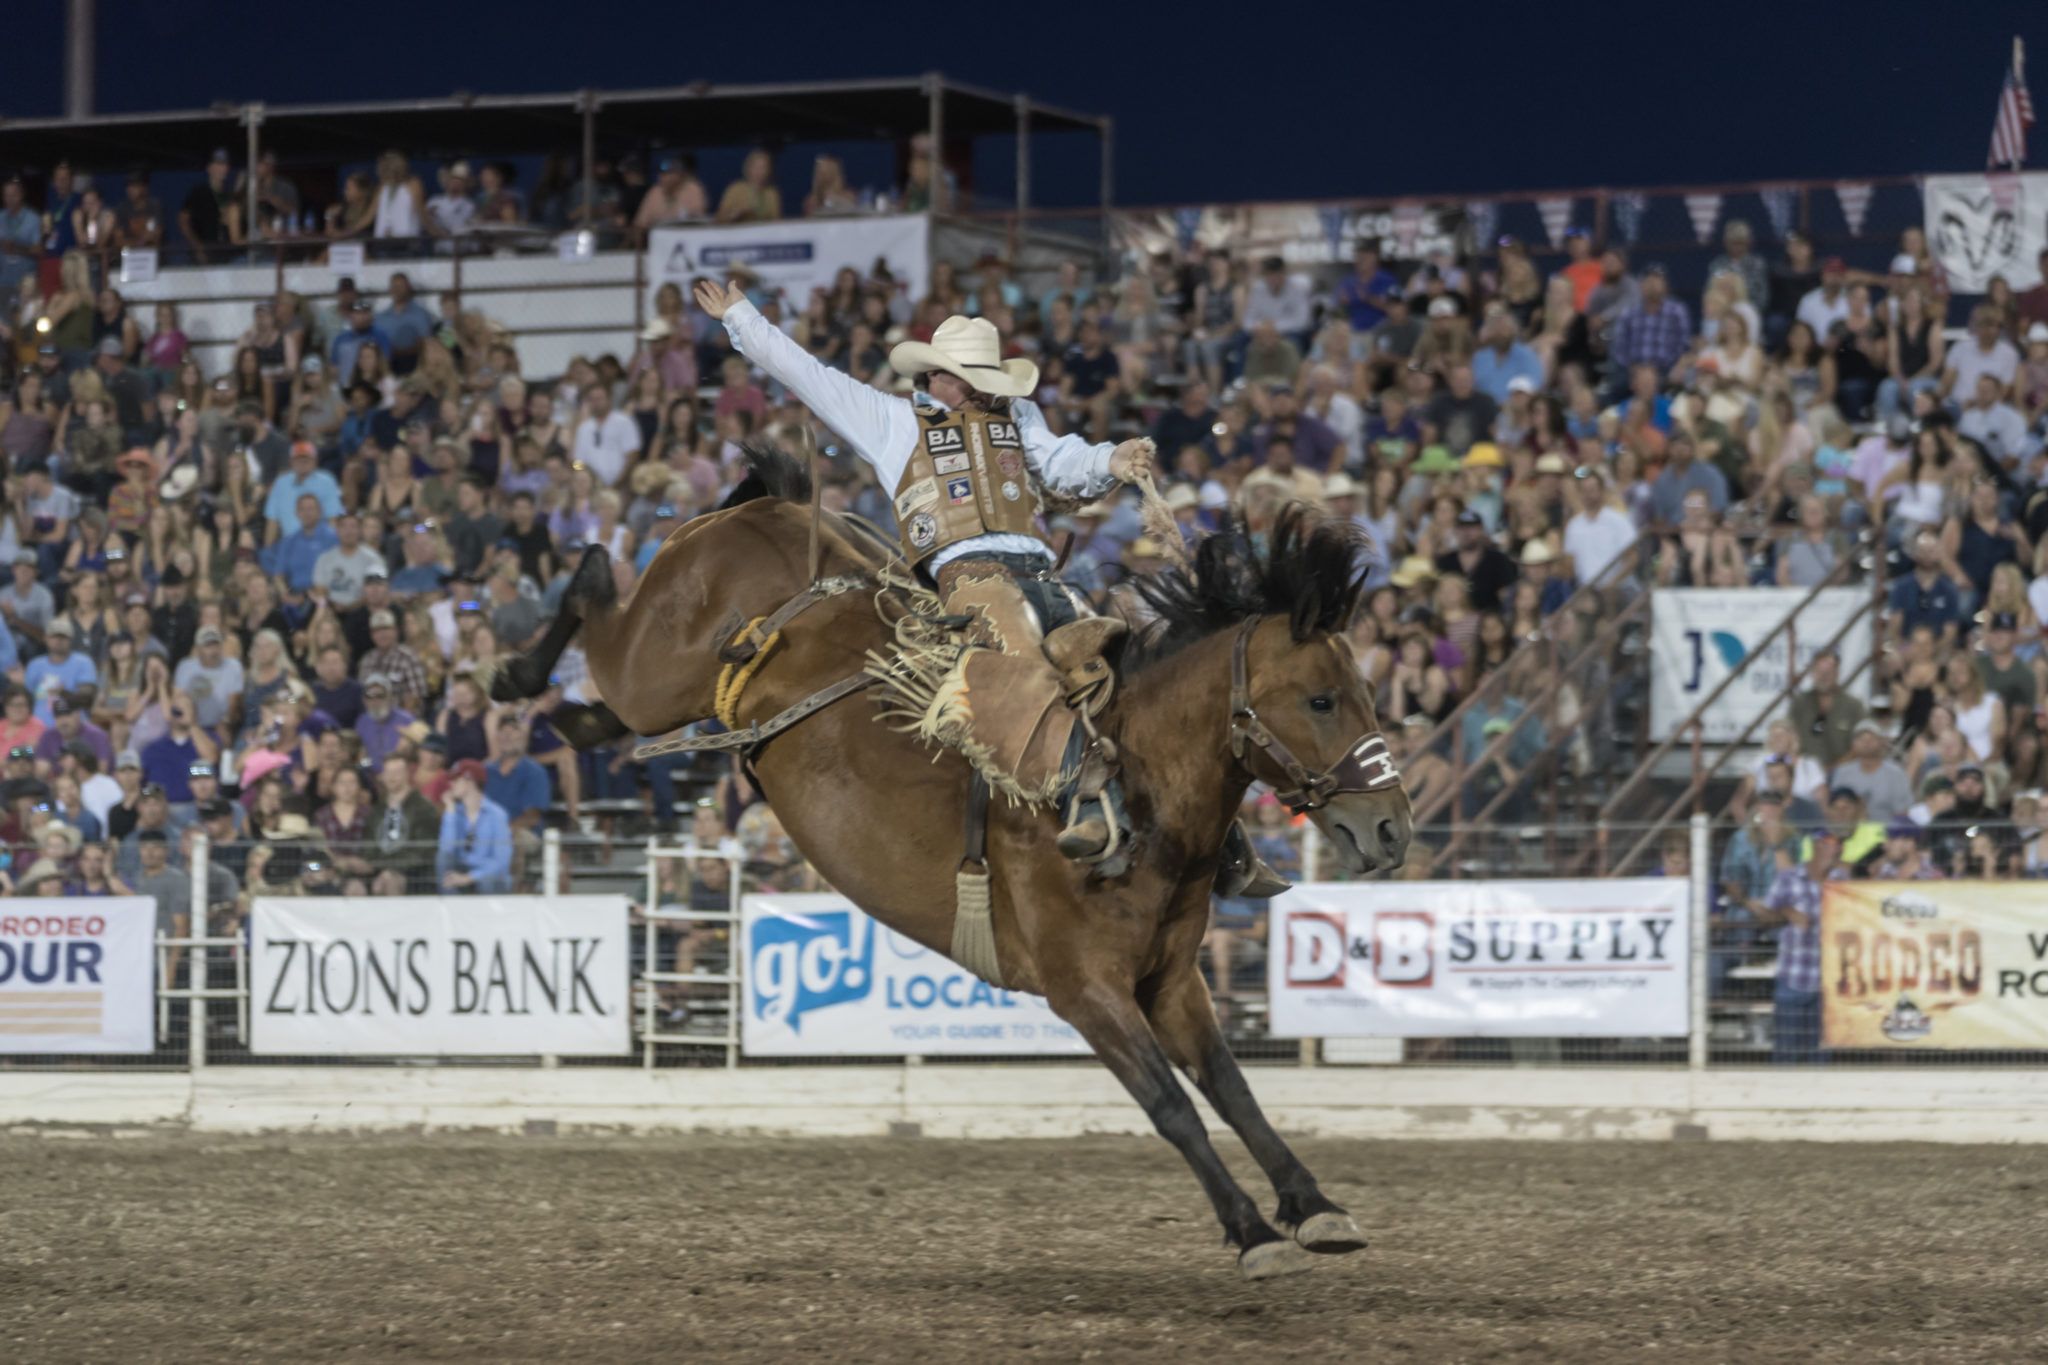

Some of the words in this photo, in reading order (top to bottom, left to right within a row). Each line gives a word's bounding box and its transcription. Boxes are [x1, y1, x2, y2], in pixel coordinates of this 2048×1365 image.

[928, 428, 961, 446] BA
[987, 423, 1018, 440] BA
[1451, 919, 1673, 962] SUPPLY
[265, 938, 431, 1016] ZIONS
[450, 938, 608, 1016] BANK
[755, 908, 865, 1020] go!
[1835, 929, 1981, 997] RODEO
[886, 974, 1016, 1009] LOCAL
[891, 1024, 941, 1039] YOUR
[948, 1024, 1003, 1039] GUIDE
[1011, 1024, 1034, 1038] TO
